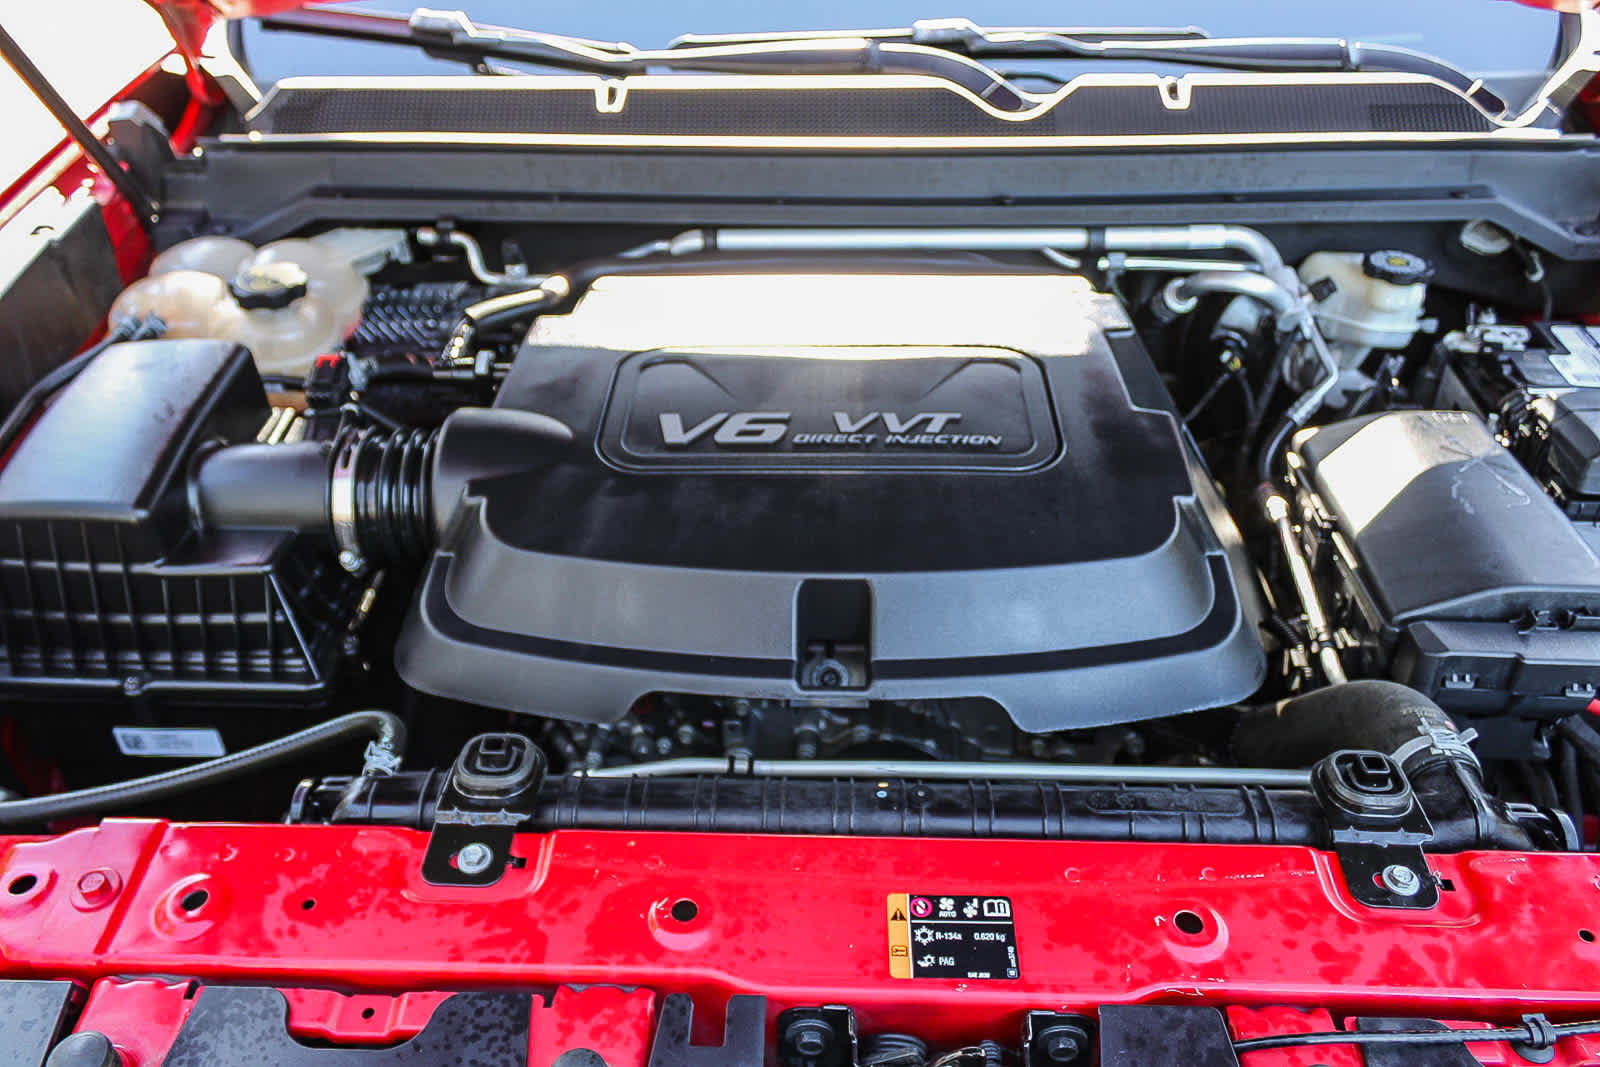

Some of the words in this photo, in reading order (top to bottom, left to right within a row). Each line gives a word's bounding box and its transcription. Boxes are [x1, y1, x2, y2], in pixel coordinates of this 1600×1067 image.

[658, 411, 792, 445] V6
[833, 411, 963, 433] VVT
[792, 433, 878, 445] DIRECT
[885, 433, 1003, 446] INJECTION
[938, 910, 957, 918] AUTO
[935, 931, 962, 941] R-134a
[995, 932, 1006, 942] kg
[938, 956, 955, 967] PAG
